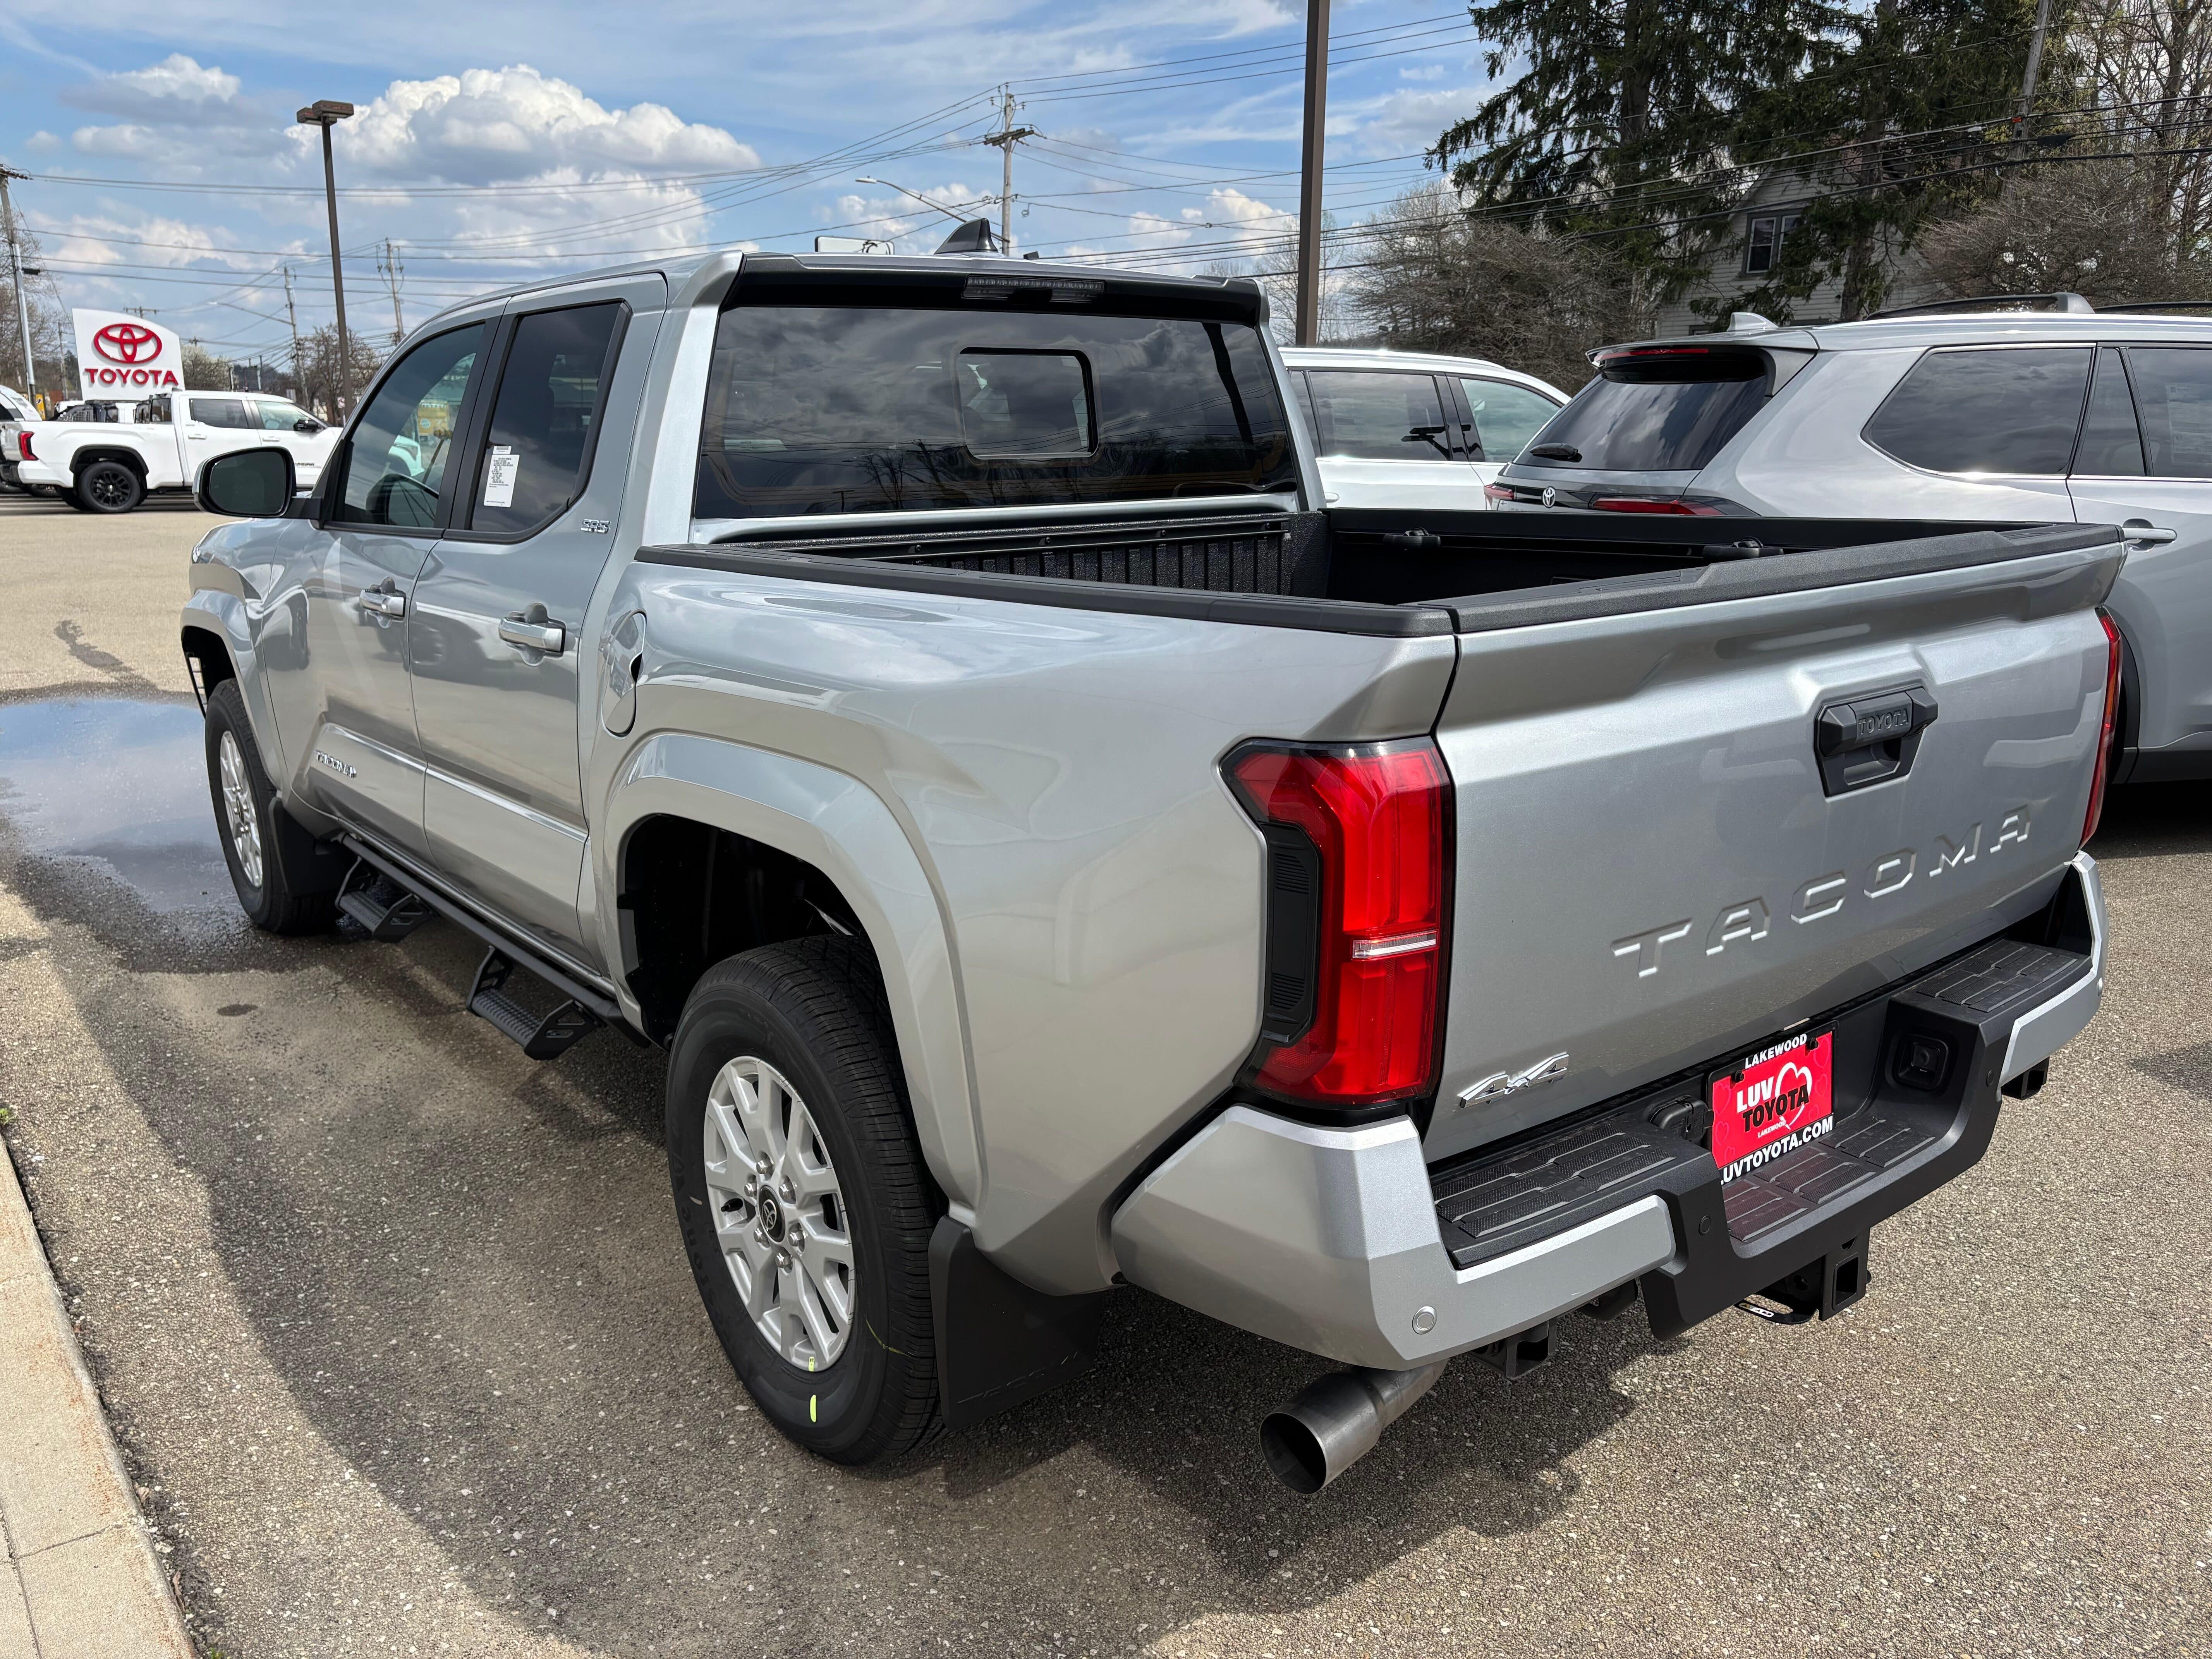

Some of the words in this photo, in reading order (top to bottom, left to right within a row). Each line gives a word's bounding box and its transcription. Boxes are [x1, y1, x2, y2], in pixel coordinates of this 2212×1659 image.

[84, 368, 179, 386] TOYOTA
[1858, 708, 1909, 735] TOYOTA
[314, 750, 357, 778] TACOMA
[1611, 804, 2031, 979] TACOMA
[1745, 1033, 1808, 1069] LAKEWOOD
[1736, 1075, 1774, 1113] LUV
[1742, 1084, 1809, 1133] TOYOTA
[1757, 1120, 1786, 1138] LAKEWOOD
[1720, 1115, 1833, 1185] UVTOYOTA.COM
